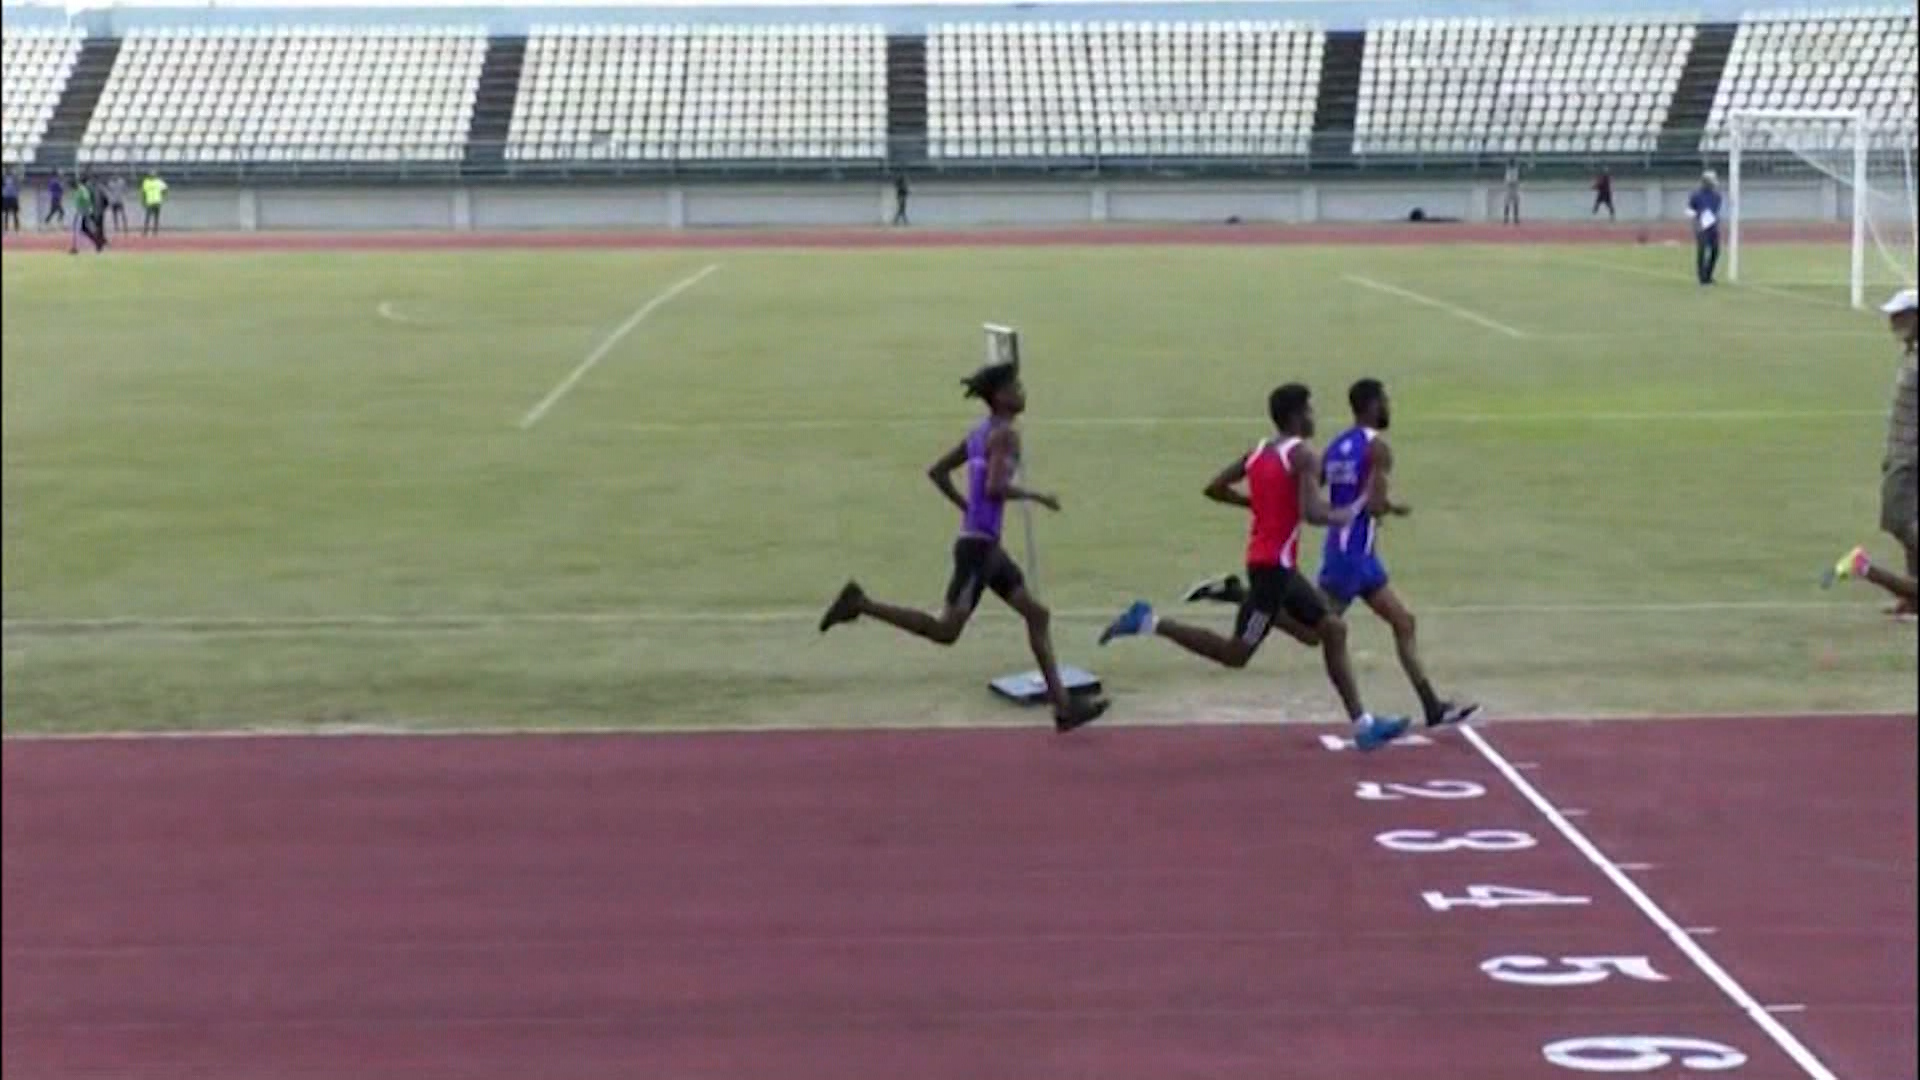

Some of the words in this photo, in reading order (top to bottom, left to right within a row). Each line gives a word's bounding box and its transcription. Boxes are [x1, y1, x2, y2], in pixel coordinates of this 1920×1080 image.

[1355, 780, 1486, 800] 2
[1375, 830, 1537, 852] 3
[1421, 884, 1591, 910] 4
[1480, 955, 1670, 985] 5
[1541, 1035, 1747, 1072] 6
